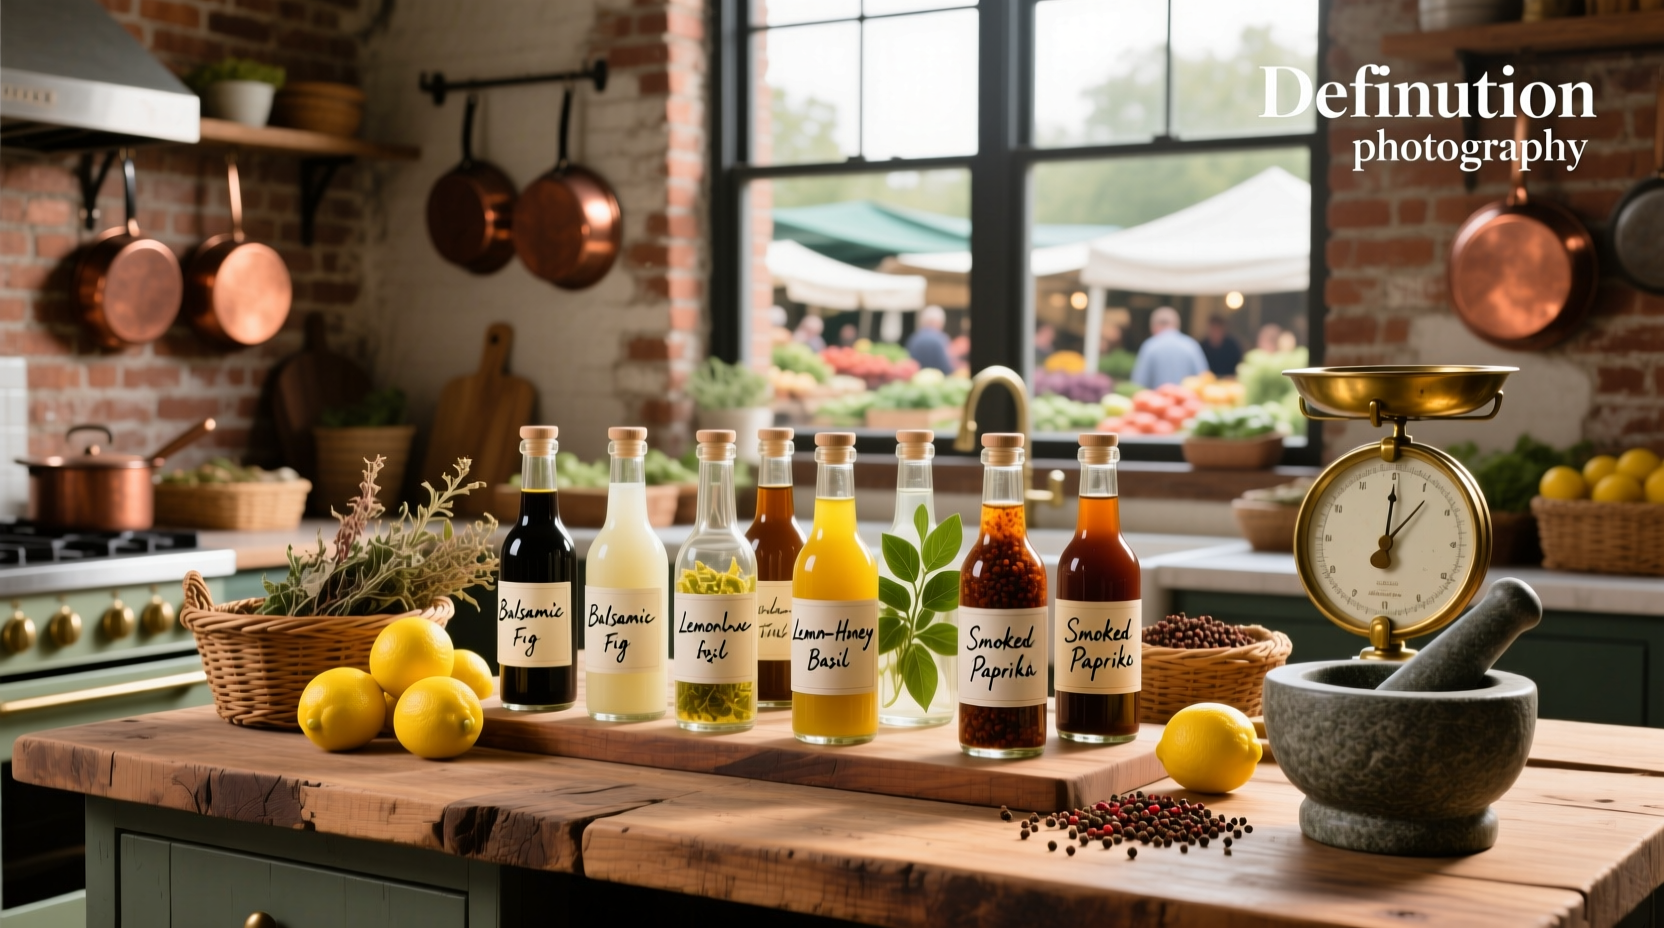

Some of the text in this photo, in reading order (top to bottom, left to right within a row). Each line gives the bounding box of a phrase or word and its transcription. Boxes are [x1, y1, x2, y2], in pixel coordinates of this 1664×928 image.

[498, 598, 564, 621] Balsamic
[588, 603, 656, 628] Balsamic
[513, 626, 541, 657] Fig
[966, 625, 1036, 651] Smoked
[1064, 617, 1133, 643] Smoked
[604, 632, 631, 663] Fig
[807, 647, 851, 672] Basil
[970, 654, 1037, 692] Paprika
